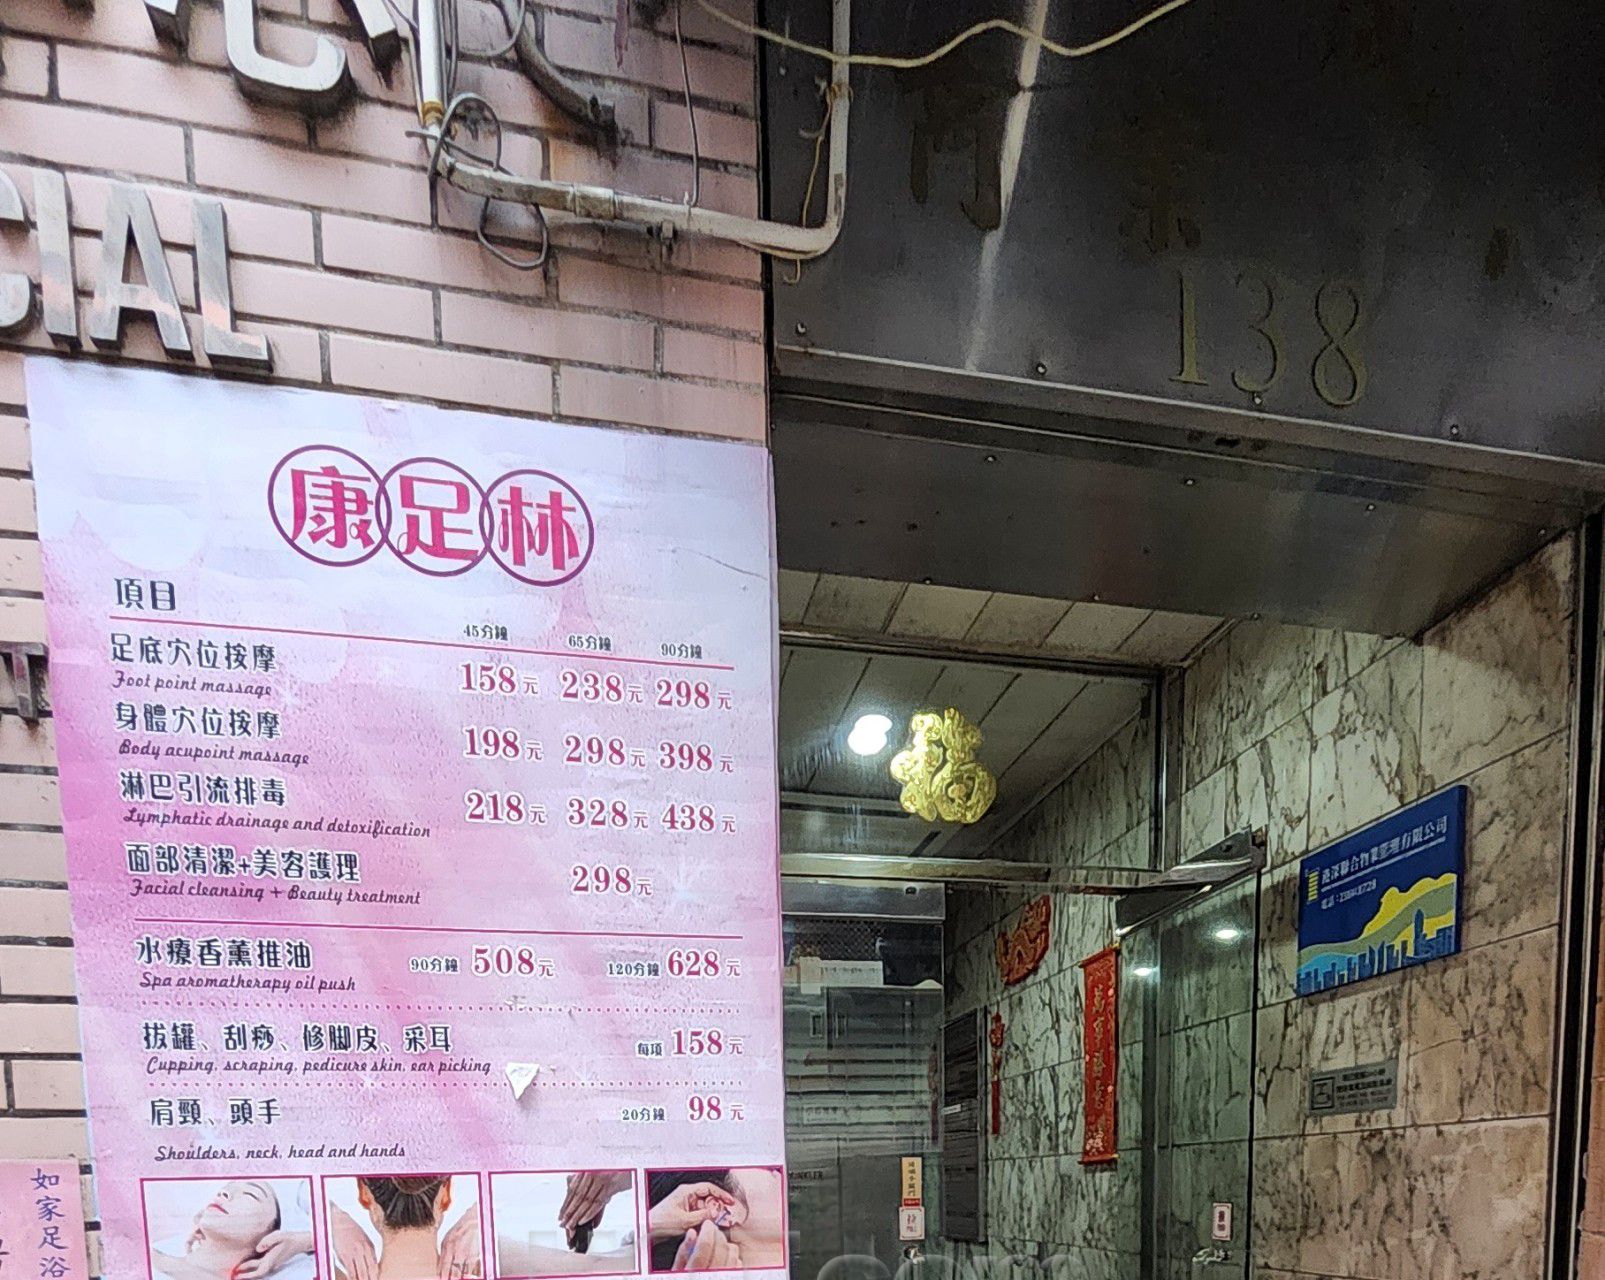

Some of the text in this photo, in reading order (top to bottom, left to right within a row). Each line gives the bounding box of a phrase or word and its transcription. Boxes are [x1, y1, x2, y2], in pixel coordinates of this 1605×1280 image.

[1168, 267, 1368, 408] 138
[290, 465, 582, 571] 康足林
[114, 577, 176, 611] 項目
[110, 633, 277, 673] 足底穴位按摩
[112, 670, 272, 699] Foot point massage
[460, 662, 732, 710] 158元 238元 298元
[115, 701, 281, 739] 身體穴位按摩
[119, 739, 310, 768] Body acupoint massage
[464, 728, 734, 773] 198元 298元 398元
[120, 771, 285, 806] 淋巴引流排毒
[123, 806, 431, 838] Lymphatic drainage and detoxification
[466, 792, 736, 833] 218元 328元 438元
[126, 843, 360, 882] 面部清潔+美容護理
[130, 879, 184, 897] Facial
[187, 883, 265, 902] cleansing
[287, 885, 343, 905] Beauty
[348, 890, 421, 904] treatment
[572, 865, 652, 896] 298元
[137, 937, 312, 969] 水療香薰推油
[473, 947, 554, 977] 508元
[667, 950, 741, 977] 628元
[139, 972, 356, 994] Spa aromatherapy oil push
[673, 1030, 743, 1055] 158元
[302, 1057, 367, 1075] pedicure
[411, 1062, 435, 1072] ear
[438, 1058, 491, 1075] picking
[689, 1095, 744, 1121] 98元
[287, 1144, 325, 1158] head
[327, 1144, 356, 1158] and
[359, 1143, 406, 1158] hands
[30, 1167, 71, 1279] 如家足浴
